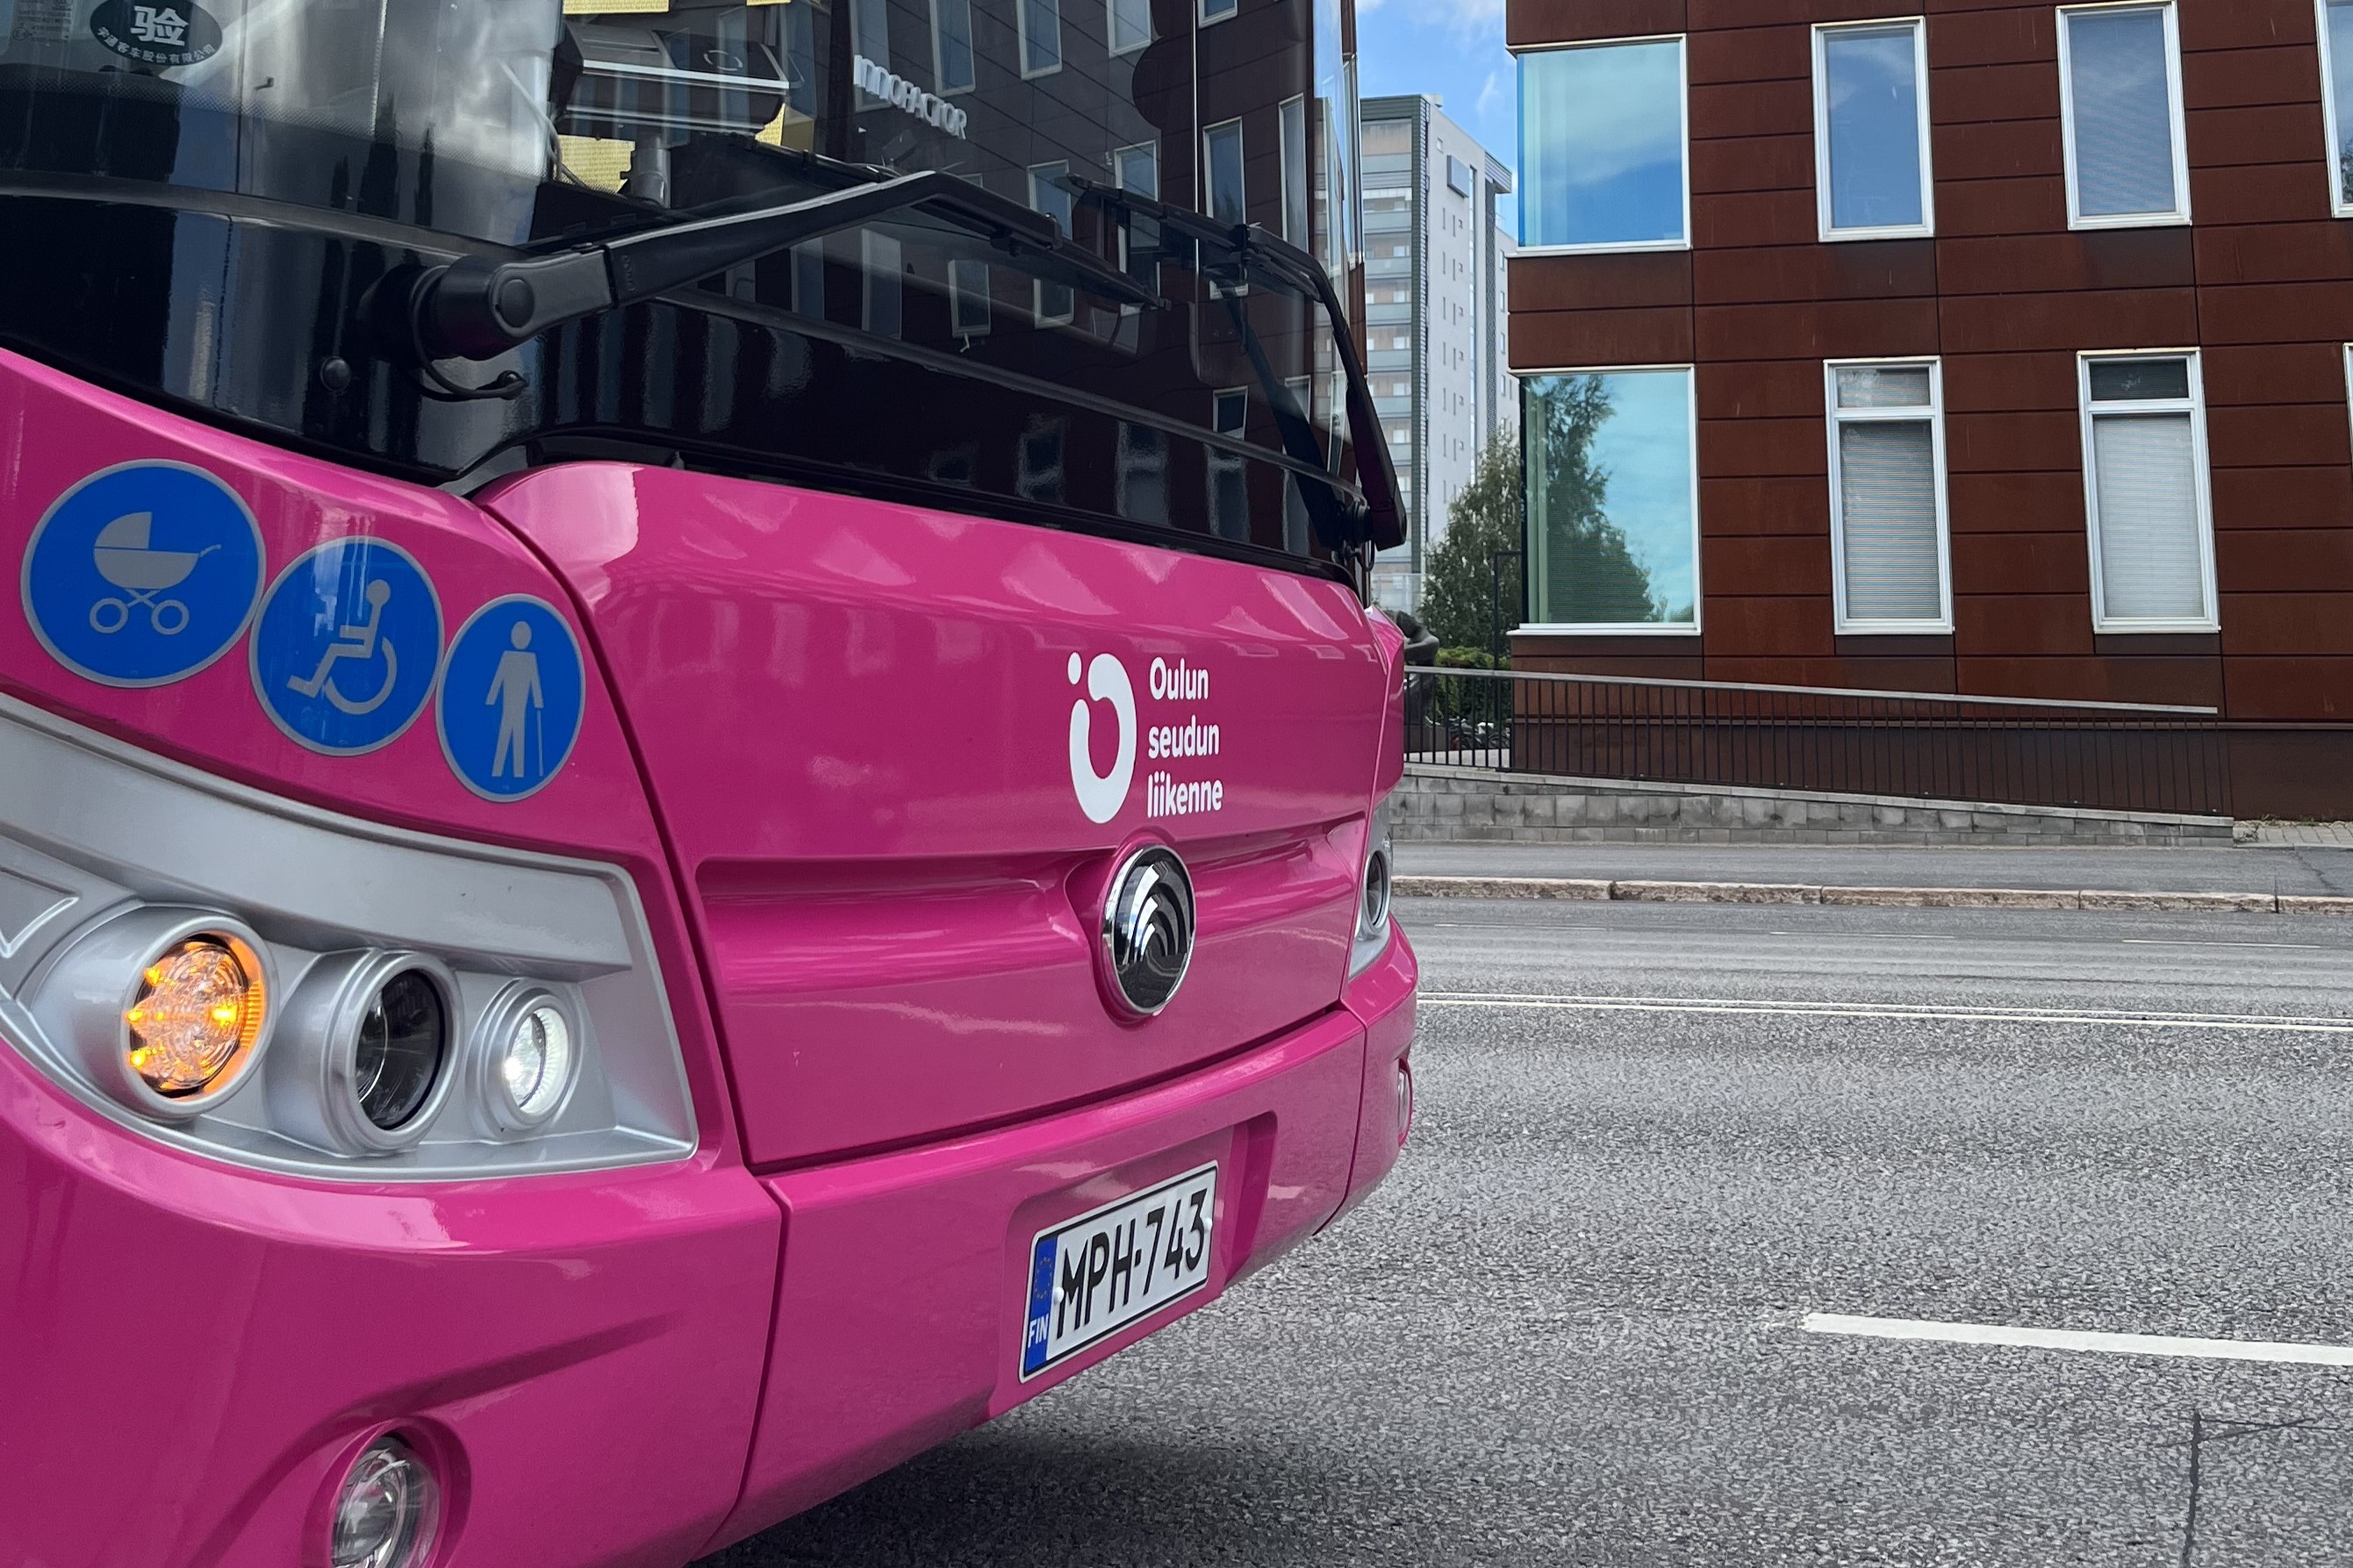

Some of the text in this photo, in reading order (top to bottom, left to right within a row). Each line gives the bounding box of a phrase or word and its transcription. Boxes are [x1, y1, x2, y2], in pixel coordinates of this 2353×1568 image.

[130, 5, 189, 47] 验
[1149, 656, 1209, 700] Oulun
[1148, 714, 1220, 760] seudun
[1147, 770, 1223, 818] liikenne
[1056, 1187, 1208, 1341] MPH-743
[1028, 1313, 1050, 1349] FIN
